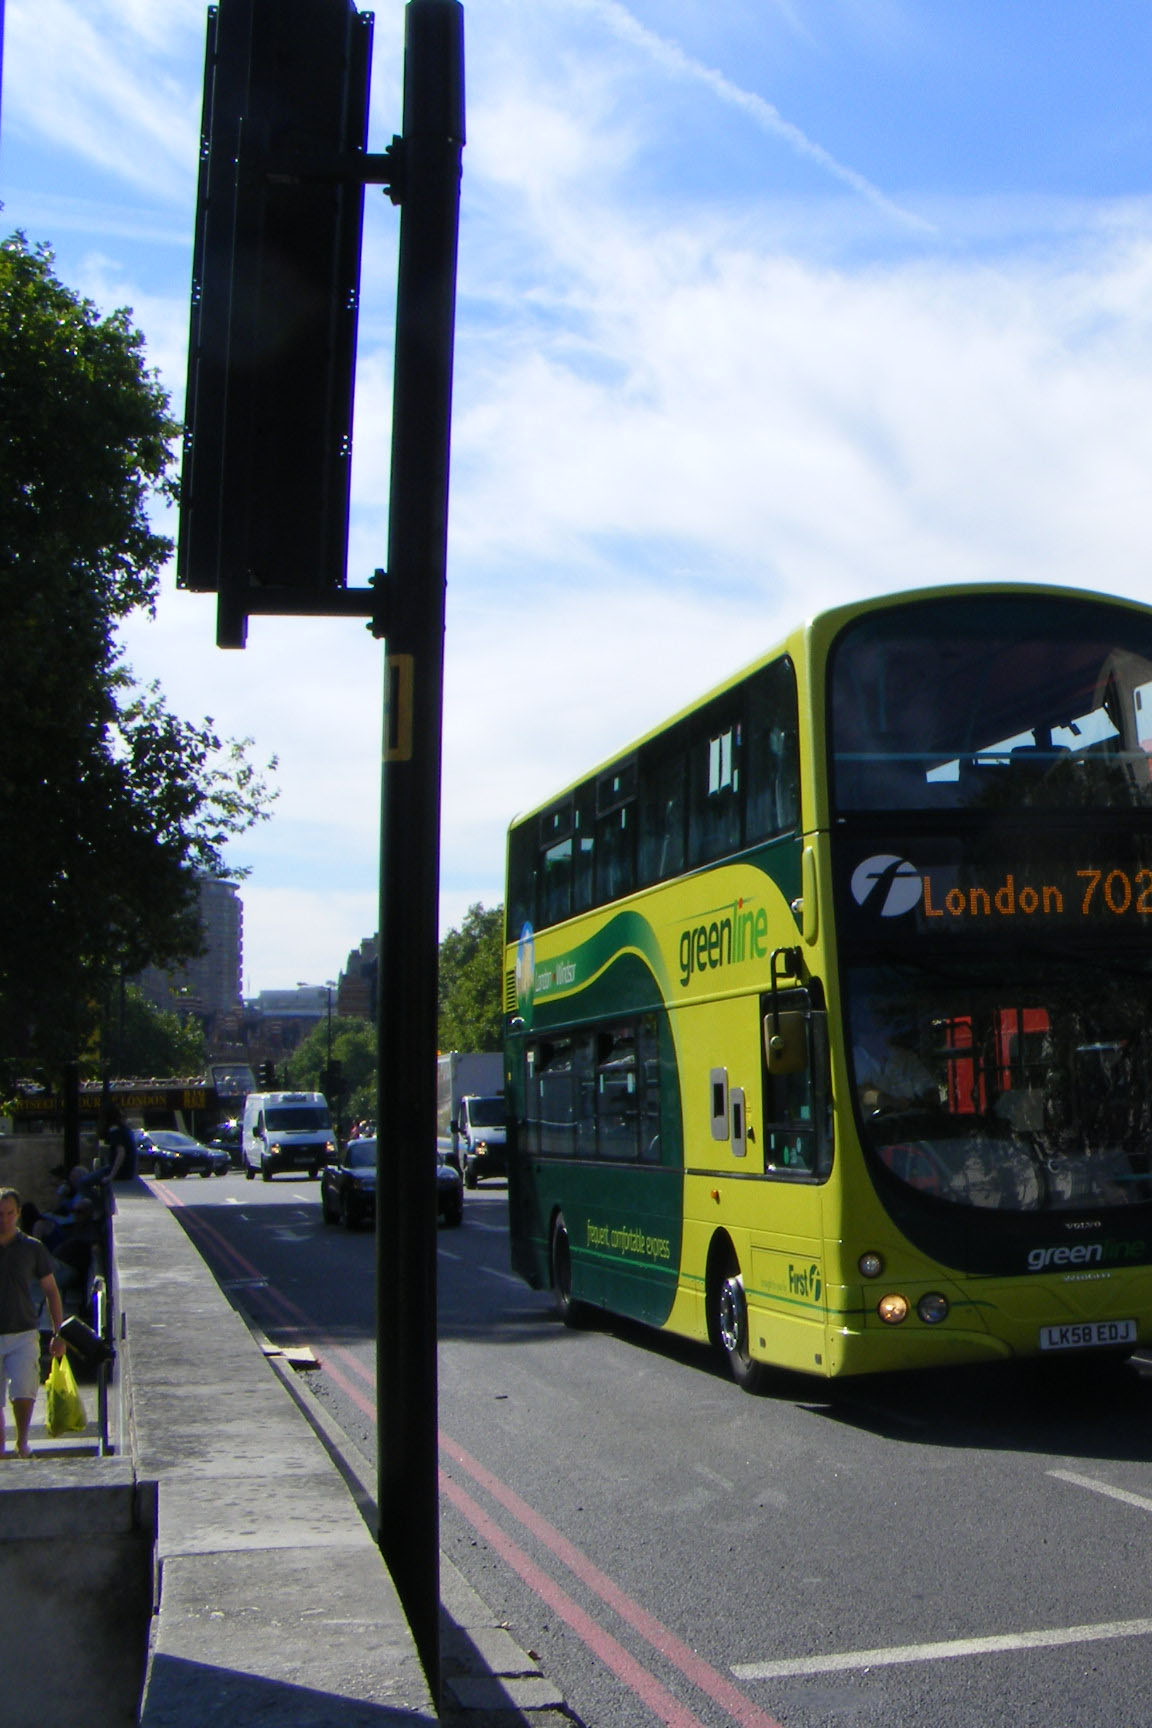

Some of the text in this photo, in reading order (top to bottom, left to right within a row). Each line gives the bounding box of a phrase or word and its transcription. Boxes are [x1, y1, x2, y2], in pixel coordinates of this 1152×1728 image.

[923, 874, 1064, 917] London
[679, 897, 768, 987] greenline
[587, 1218, 671, 1262] frequent comfortable express
[1065, 1220, 1102, 1230] VOLVO
[1027, 1239, 1145, 1271] greenline
[789, 1264, 809, 1297] First
[1048, 1322, 1130, 1345] LK58 EDJ
